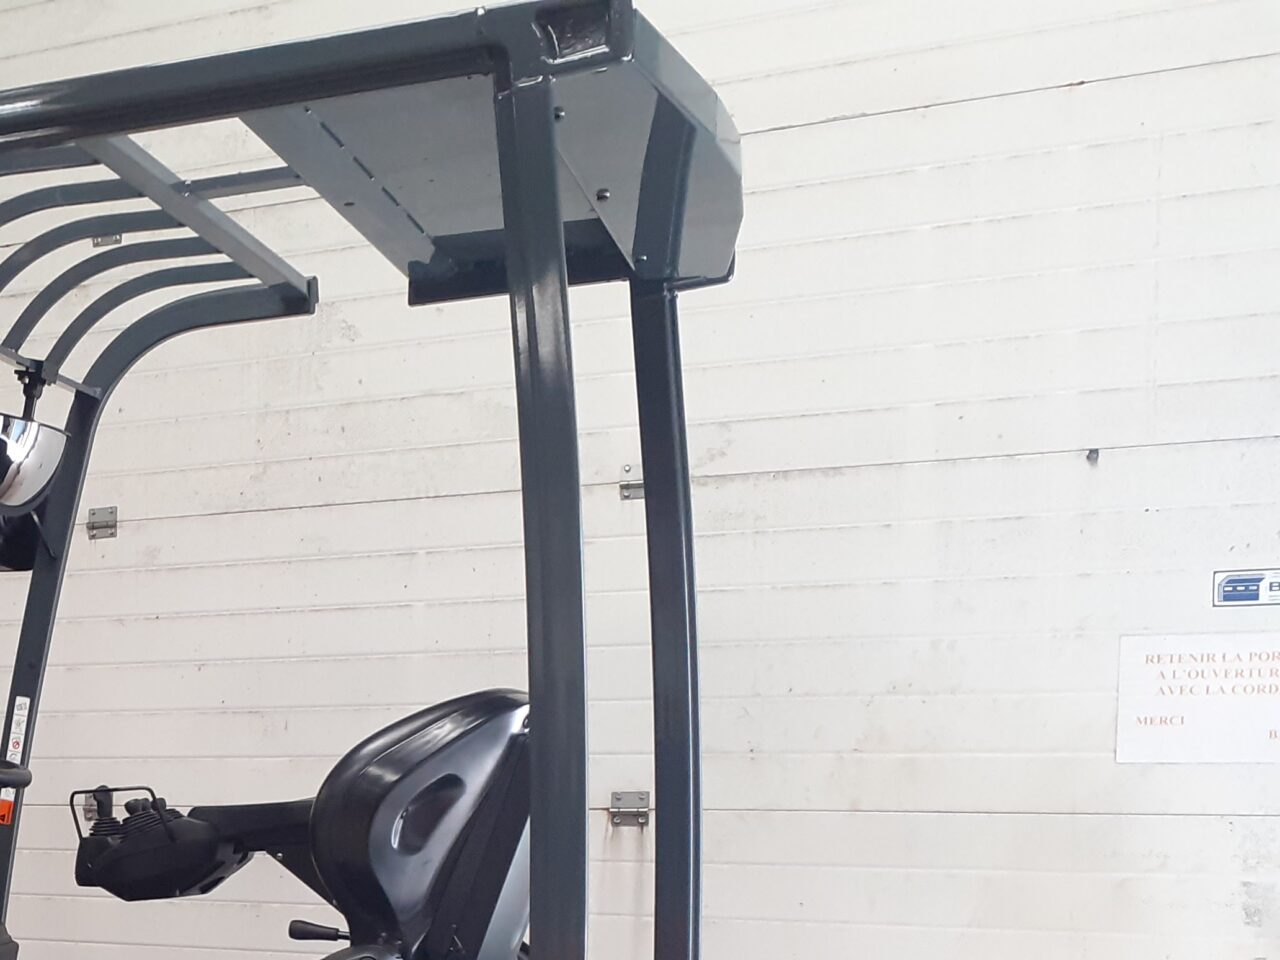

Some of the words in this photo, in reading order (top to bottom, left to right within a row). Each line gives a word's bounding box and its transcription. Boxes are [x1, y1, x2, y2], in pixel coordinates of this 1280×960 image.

[1145, 652, 1217, 664] RETENIR
[1222, 652, 1243, 663] LA
[1157, 685, 1197, 696] AVEC
[1205, 684, 1226, 696] LA
[1231, 683, 1280, 695] CORD
[1136, 715, 1185, 726] MERCI
